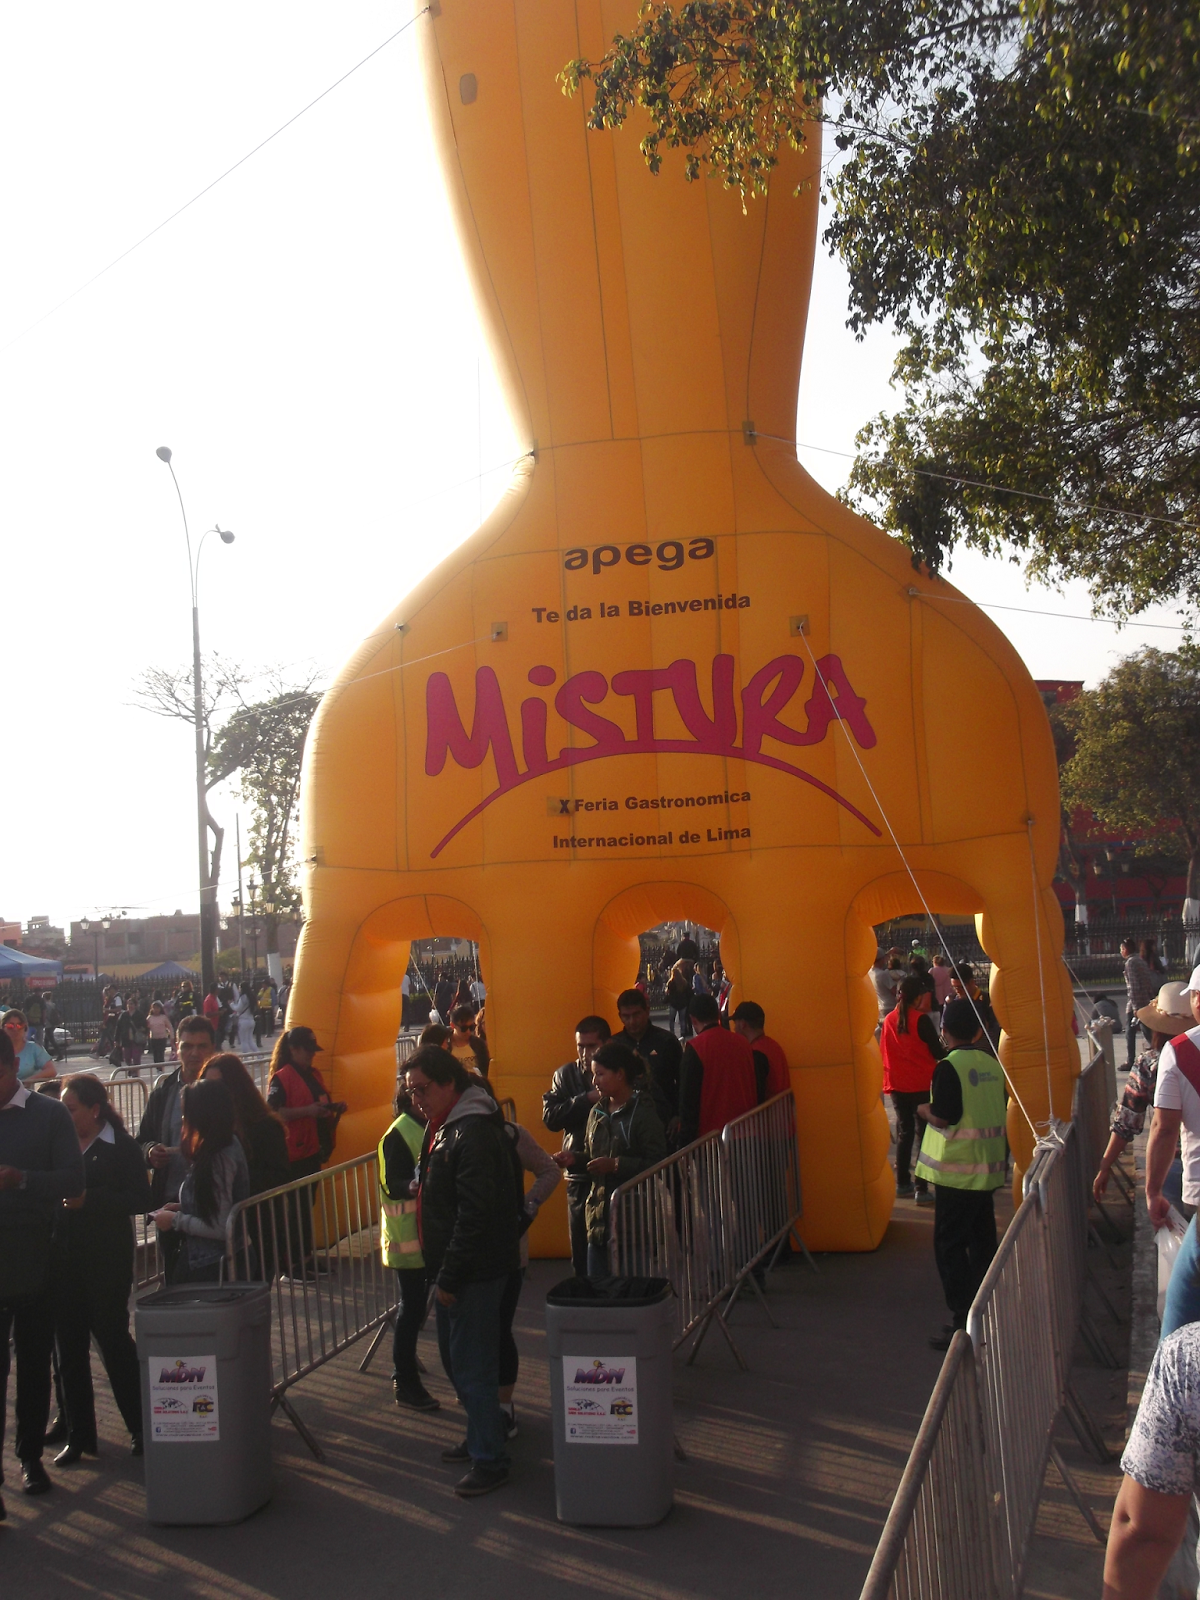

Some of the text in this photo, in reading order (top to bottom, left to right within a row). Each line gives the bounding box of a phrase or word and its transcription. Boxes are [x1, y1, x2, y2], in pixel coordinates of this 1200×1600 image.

[564, 537, 715, 574] apega
[532, 593, 751, 624] Te da la Bienvenida
[559, 790, 751, 814] X Feria Gastronomica
[552, 826, 751, 849] Internacional de Lima
[574, 1368, 625, 1384] MDN
